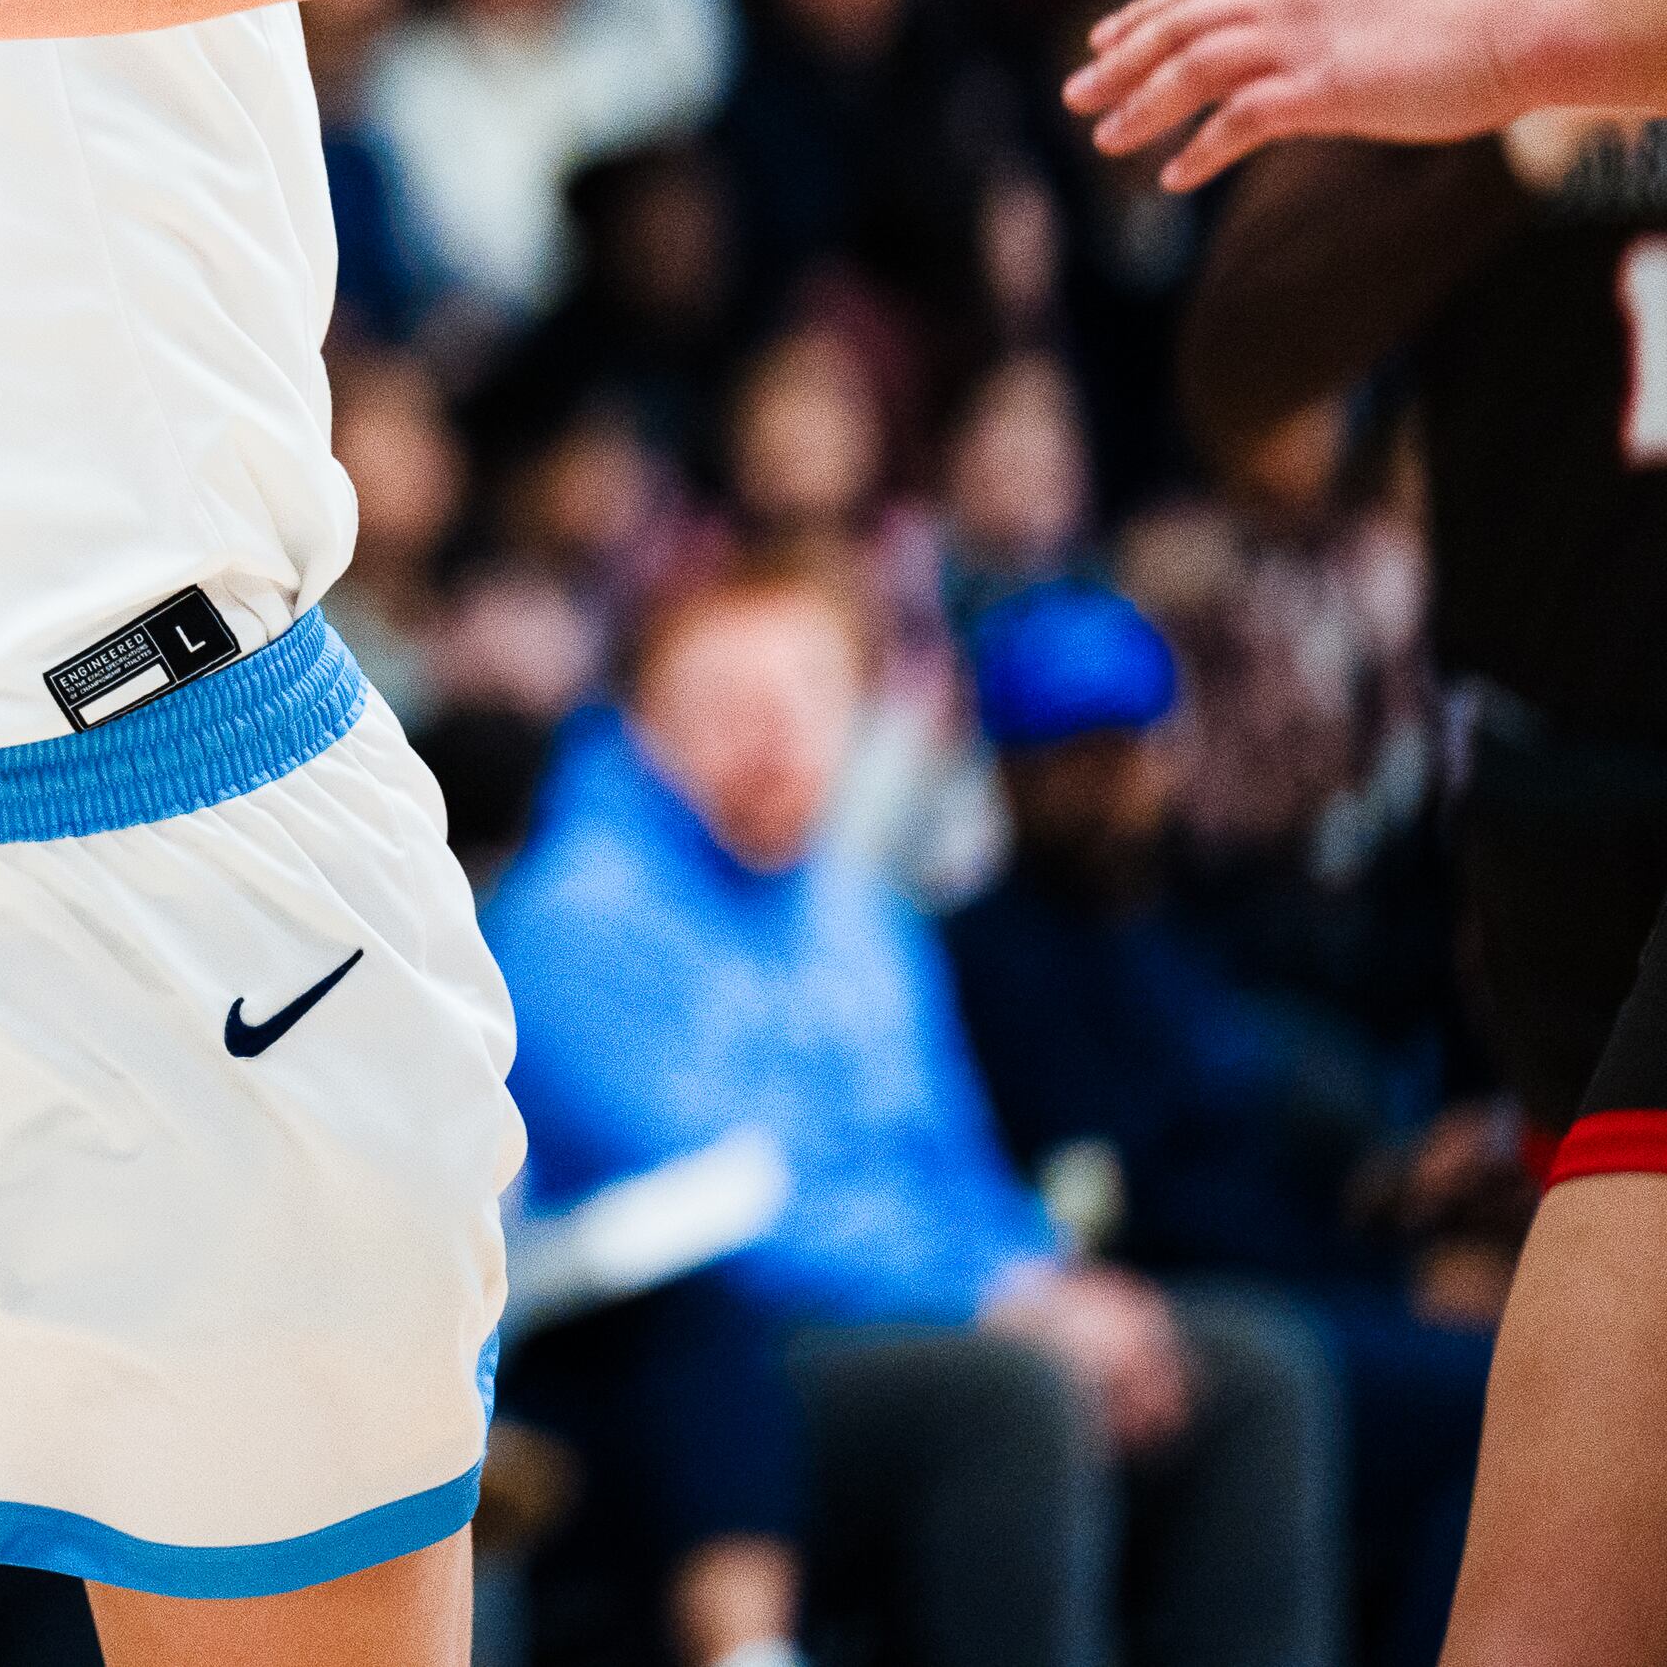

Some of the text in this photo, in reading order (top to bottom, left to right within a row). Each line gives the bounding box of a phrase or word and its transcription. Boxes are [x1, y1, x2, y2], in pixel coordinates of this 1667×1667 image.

[175, 625, 207, 653] L
[59, 633, 144, 688] ENGINEERED
[75, 679, 87, 688] THE
[87, 669, 105, 682] EXACT
